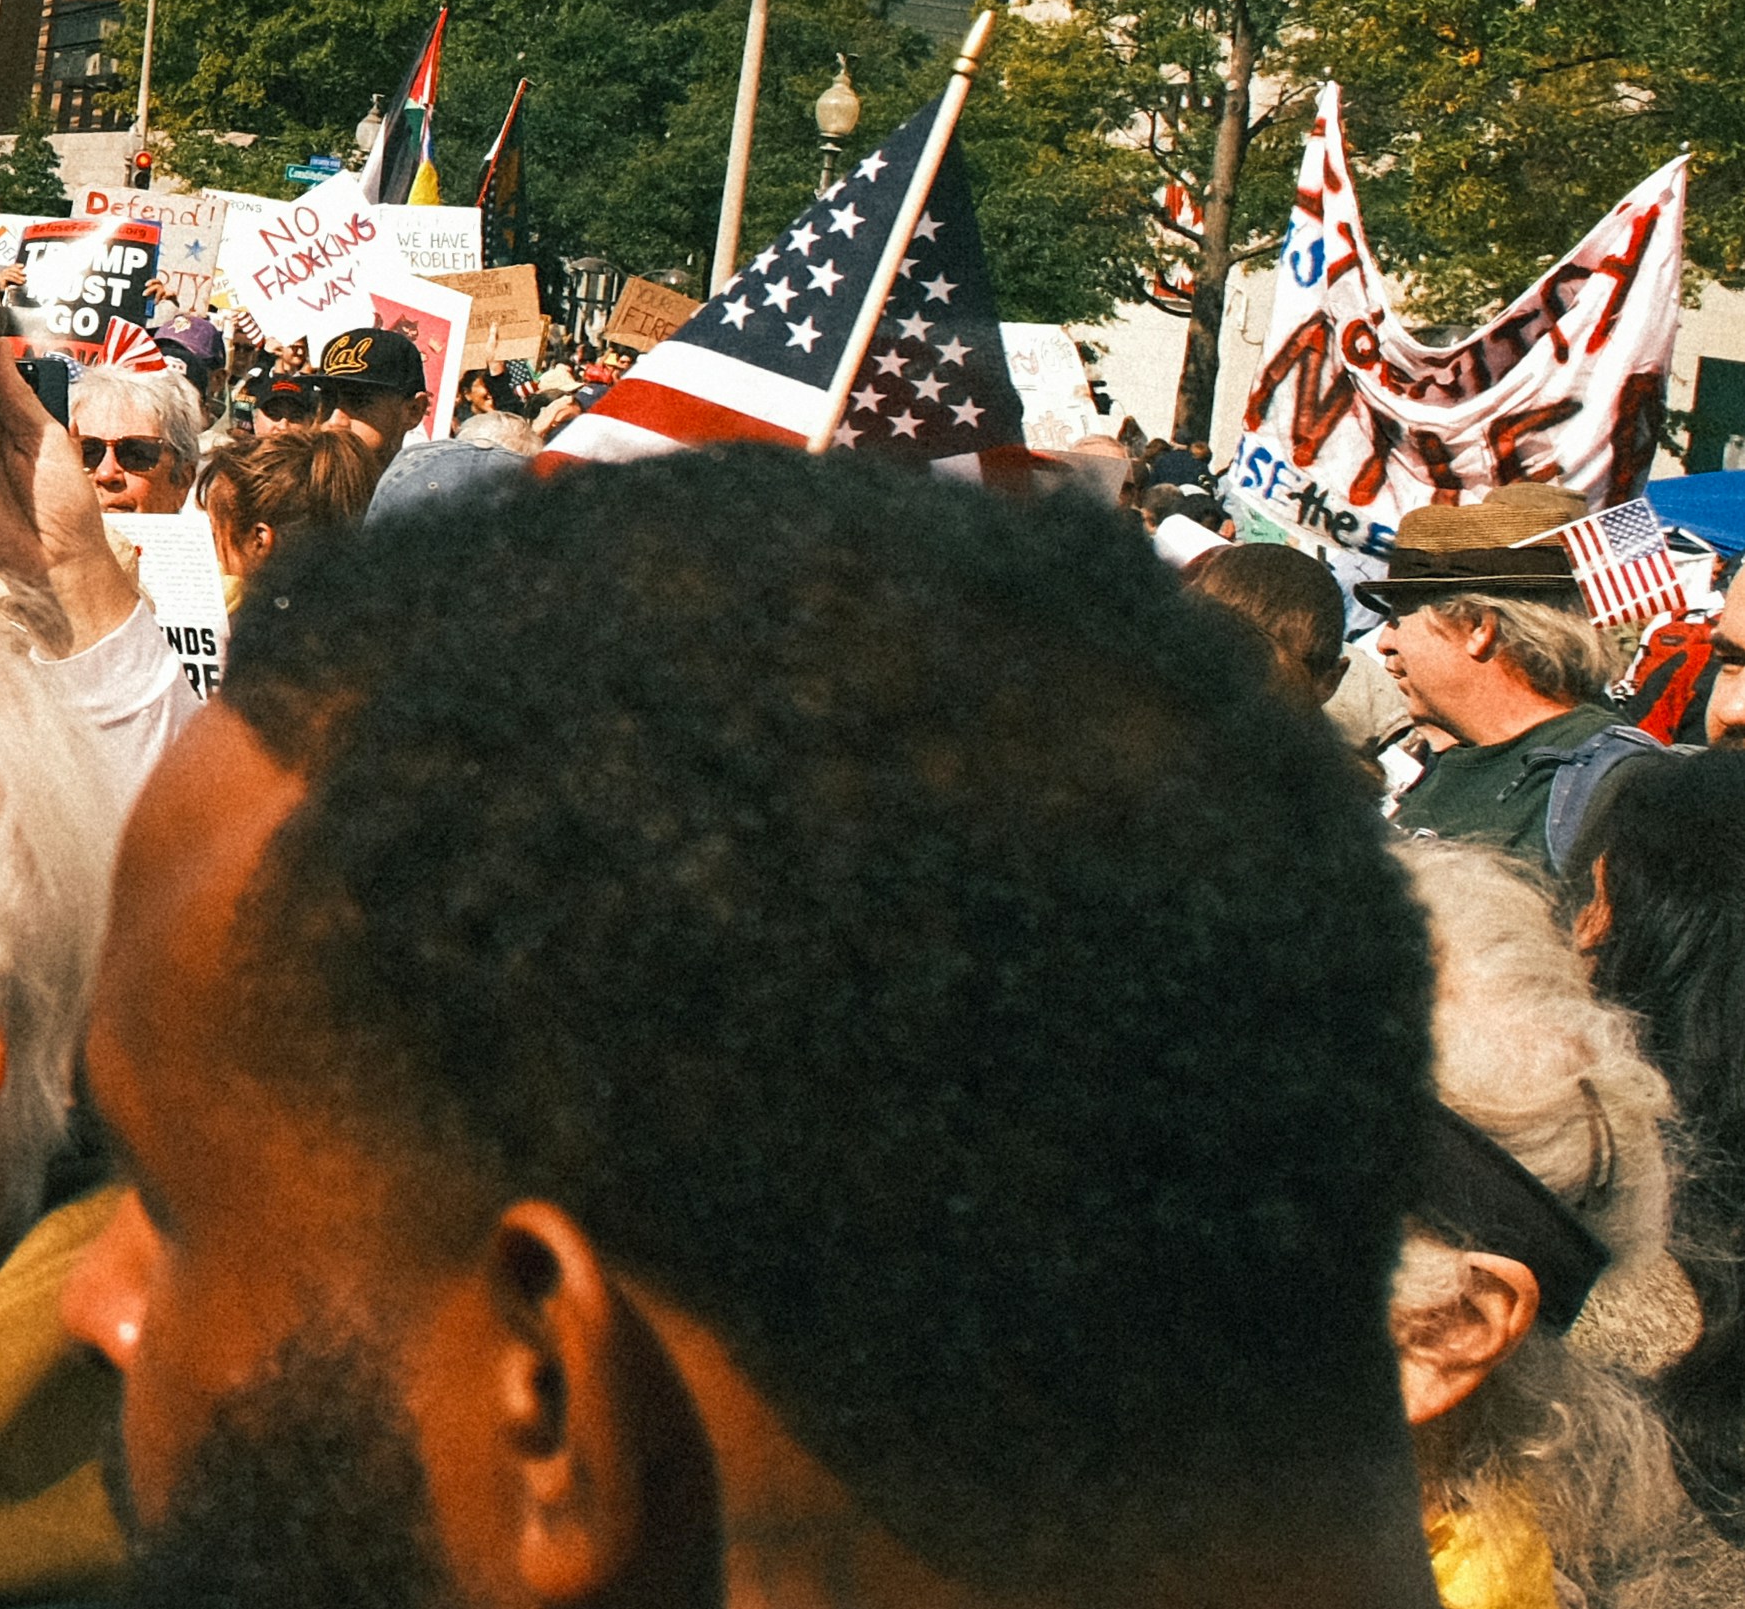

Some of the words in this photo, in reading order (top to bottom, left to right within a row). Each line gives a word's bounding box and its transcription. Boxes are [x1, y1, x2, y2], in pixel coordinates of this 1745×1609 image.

[258, 206, 320, 258] NO
[397, 232, 422, 248] WE
[430, 232, 469, 249] HAVE
[297, 267, 356, 312] WAY
[46, 304, 99, 337] GO
[323, 335, 374, 376] Cal
